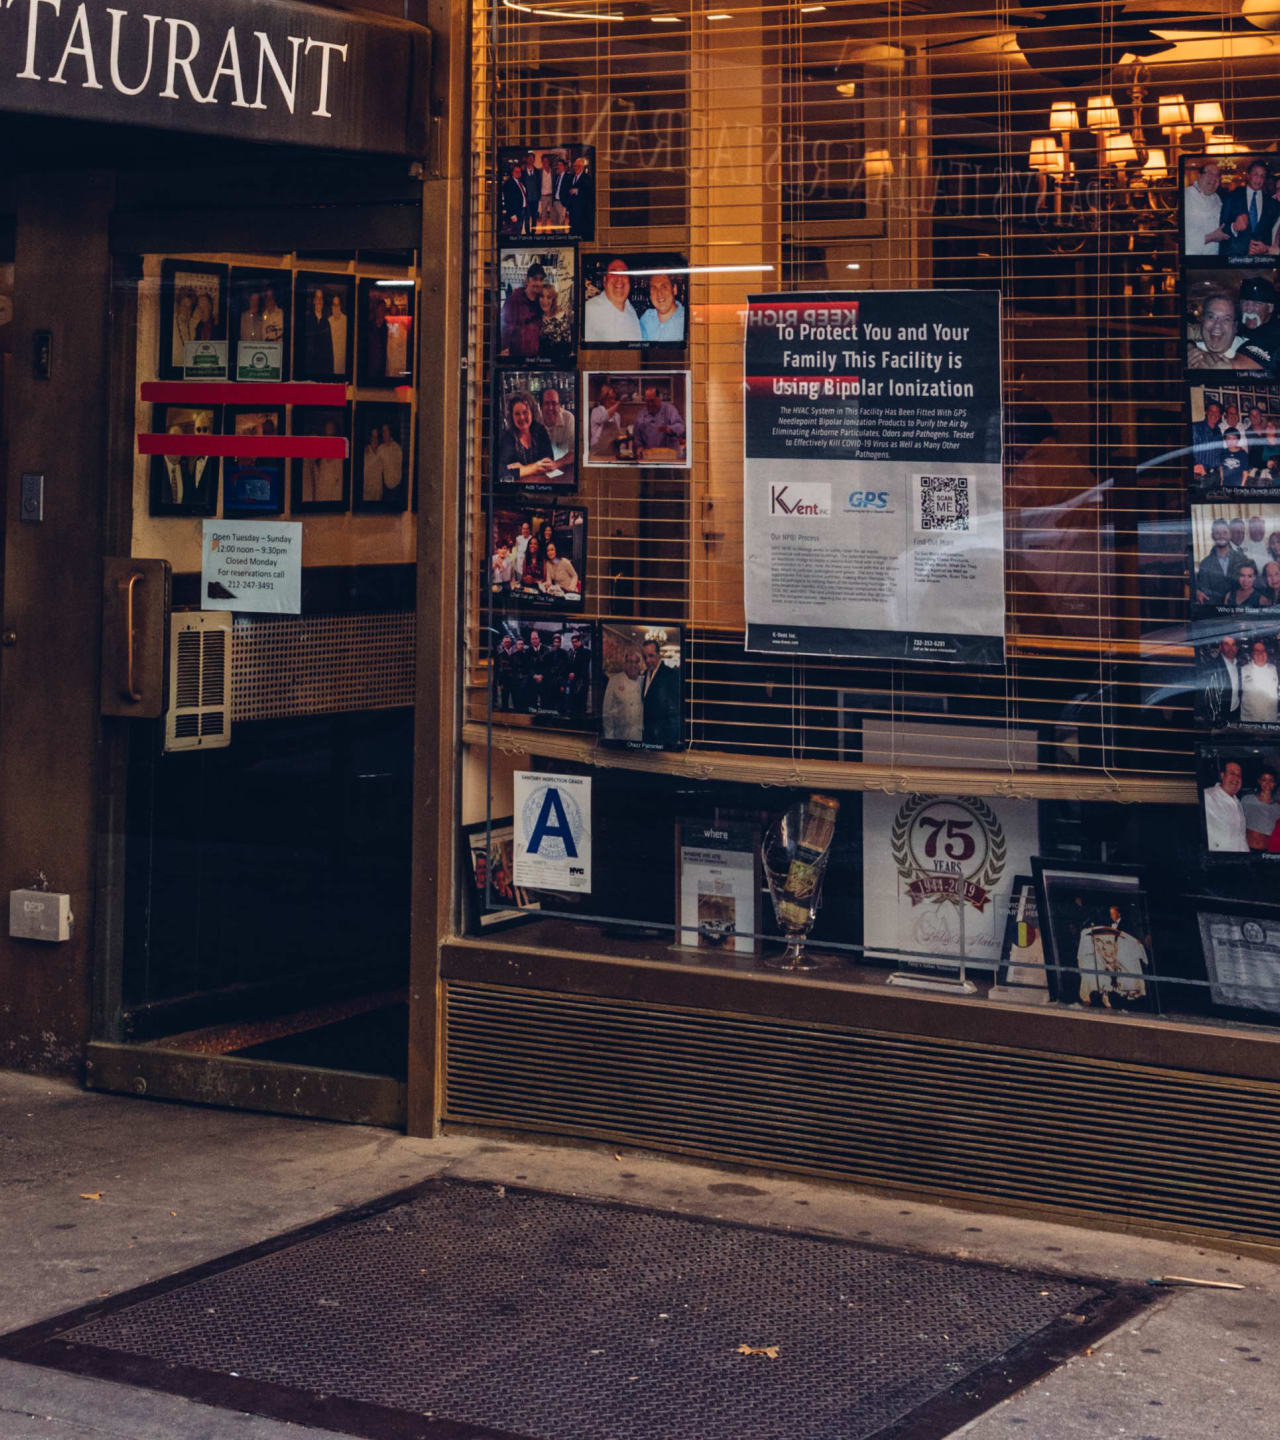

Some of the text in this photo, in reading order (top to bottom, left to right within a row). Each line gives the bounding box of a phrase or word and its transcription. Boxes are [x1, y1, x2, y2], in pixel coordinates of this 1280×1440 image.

[776, 323, 970, 341] To Protect You and Your
[783, 351, 962, 373] Family This Facility is
[773, 379, 974, 400] Using Bipolar Ionization
[811, 407, 835, 416] System
[844, 407, 858, 415] This
[859, 408, 883, 417] Facility
[884, 408, 897, 416] Has
[898, 408, 915, 416] Been
[936, 408, 952, 417] With
[778, 417, 817, 426] Needlepoint
[878, 418, 906, 427] Products
[916, 419, 936, 428] Purify
[937, 419, 947, 427] the
[960, 420, 968, 429] by
[772, 427, 810, 437] Eliminating
[902, 429, 914, 438] and
[848, 490, 890, 509] GPS
[936, 502, 953, 512] ME
[212, 533, 292, 544] Open Tuesday Sunday
[261, 546, 288, 555] 9:30pm
[226, 557, 277, 567] Closed Monday
[218, 568, 229, 576] For
[230, 568, 272, 578] reservations
[526, 788, 579, 859] A
[704, 828, 728, 840] where
[919, 817, 976, 861] 75
[933, 860, 962, 873] YEARS
